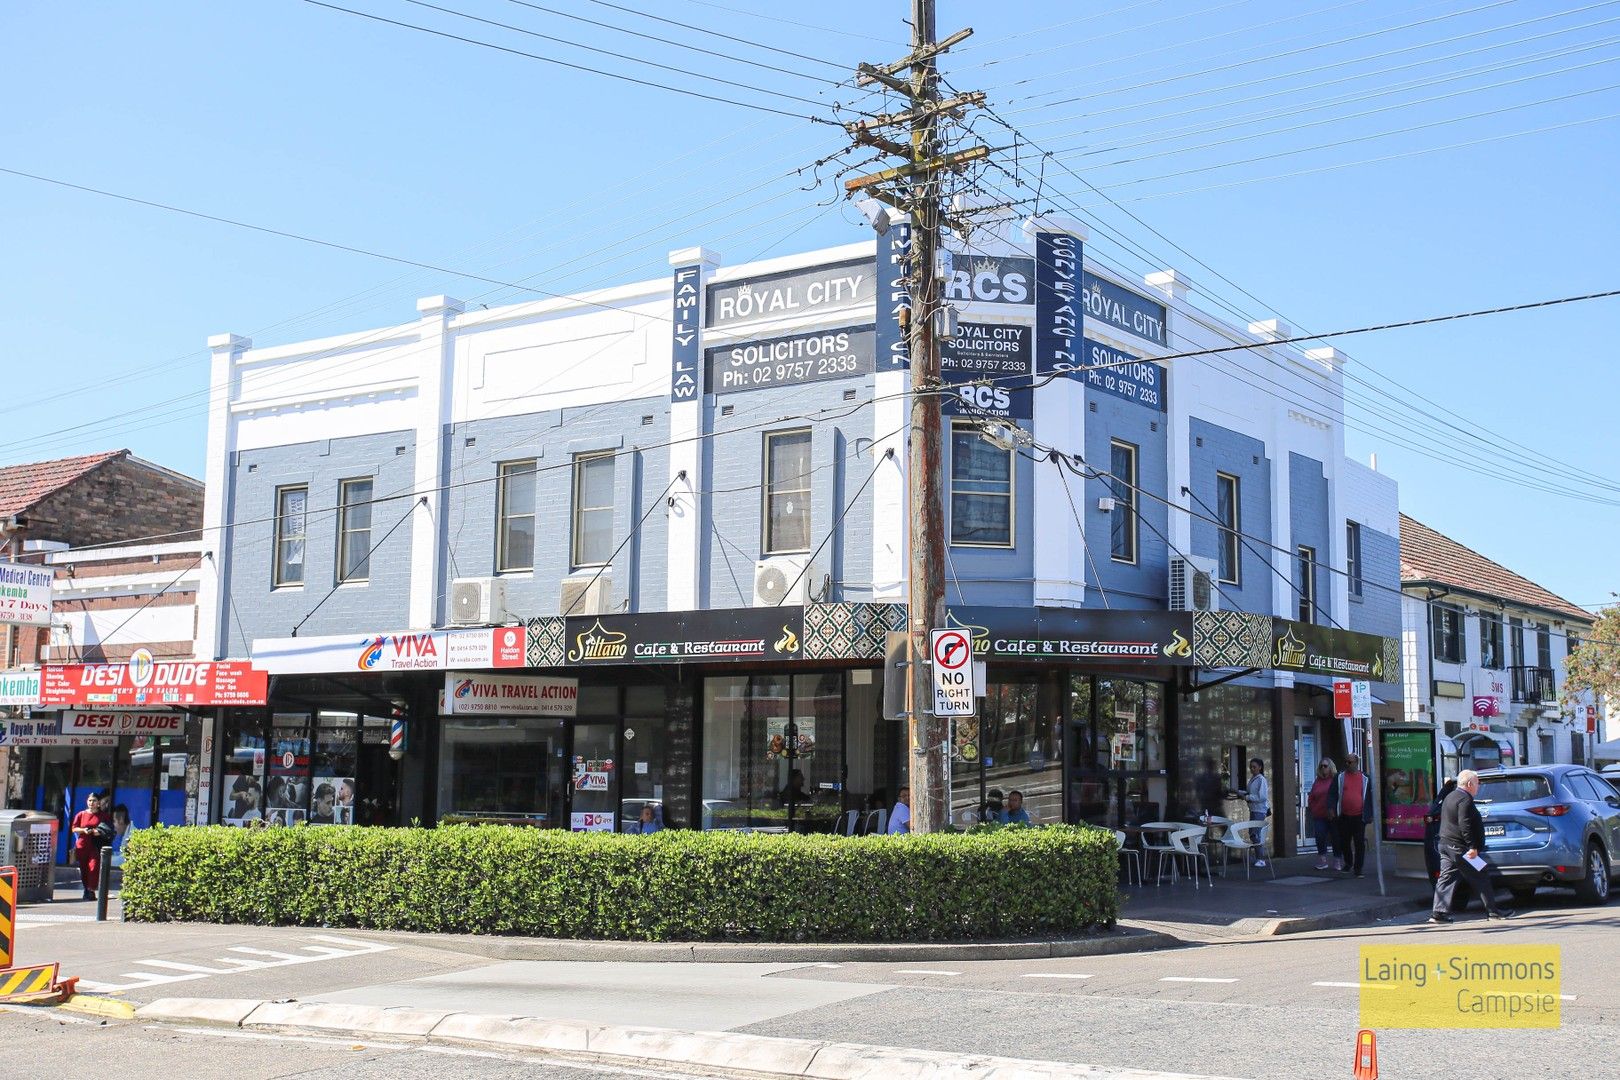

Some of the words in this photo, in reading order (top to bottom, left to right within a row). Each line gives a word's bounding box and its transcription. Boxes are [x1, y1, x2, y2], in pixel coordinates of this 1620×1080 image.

[945, 270, 1028, 302] RCS
[719, 287, 800, 320] ROYAL
[807, 275, 864, 305] CITY
[1052, 237, 1076, 373] CONVEYANCING
[675, 270, 697, 346] FAMILY
[1083, 288, 1130, 327] ROYAL
[1134, 311, 1163, 341] CITY
[957, 325, 991, 340] OYAL
[994, 328, 1023, 341] CITY
[731, 332, 849, 367] SOLICITORS
[948, 339, 1019, 353] SOLICITORS
[723, 371, 748, 387] Ph:
[753, 367, 771, 383] 02
[776, 361, 813, 381] 9757
[818, 355, 857, 375] 2333
[942, 358, 958, 367] Ph:
[961, 359, 973, 368] 02
[976, 360, 999, 369] 9757
[1002, 361, 1026, 370] 2333
[1092, 346, 1155, 386] SOLICITORS
[674, 361, 696, 398] LAW
[1089, 372, 1102, 386] Ph:
[1105, 376, 1115, 391] 02
[1118, 381, 1136, 397] 9757
[1140, 389, 1157, 405] 2333
[960, 386, 1010, 409] RCS
[0, 567, 27, 584] Medical
[28, 570, 50, 587] Centre
[0, 585, 28, 598] kemba
[8, 600, 16, 608] 7
[21, 600, 48, 612] Days
[392, 634, 437, 658] VIVA
[568, 630, 627, 662] Sultano
[635, 641, 667, 657] Cafe
[670, 643, 679, 654] &
[684, 639, 765, 654] Restaurant
[994, 639, 1036, 655] Cafe
[1043, 641, 1053, 653] &
[1059, 641, 1158, 655] Restaurant
[391, 659, 413, 668] Travel
[414, 659, 438, 668] Action
[1309, 655, 1326, 669] Cafe
[1333, 658, 1370, 673] Restaurant
[81, 665, 126, 686] DESI
[154, 664, 211, 686] DUDE
[942, 672, 964, 685] NO
[0, 676, 38, 696] kemba
[472, 684, 498, 697] VIVA
[502, 685, 538, 698] TRAVEL
[541, 686, 577, 699] ACTION
[937, 688, 970, 698] RIGHT
[1491, 682, 1504, 694] SMS
[940, 701, 969, 710] TURN
[10, 722, 34, 737] Royale
[74, 714, 116, 727] DESI
[136, 716, 180, 729] DUDE
[12, 737, 30, 745] Open
[41, 737, 58, 745] Days
[590, 776, 606, 785] VIVA
